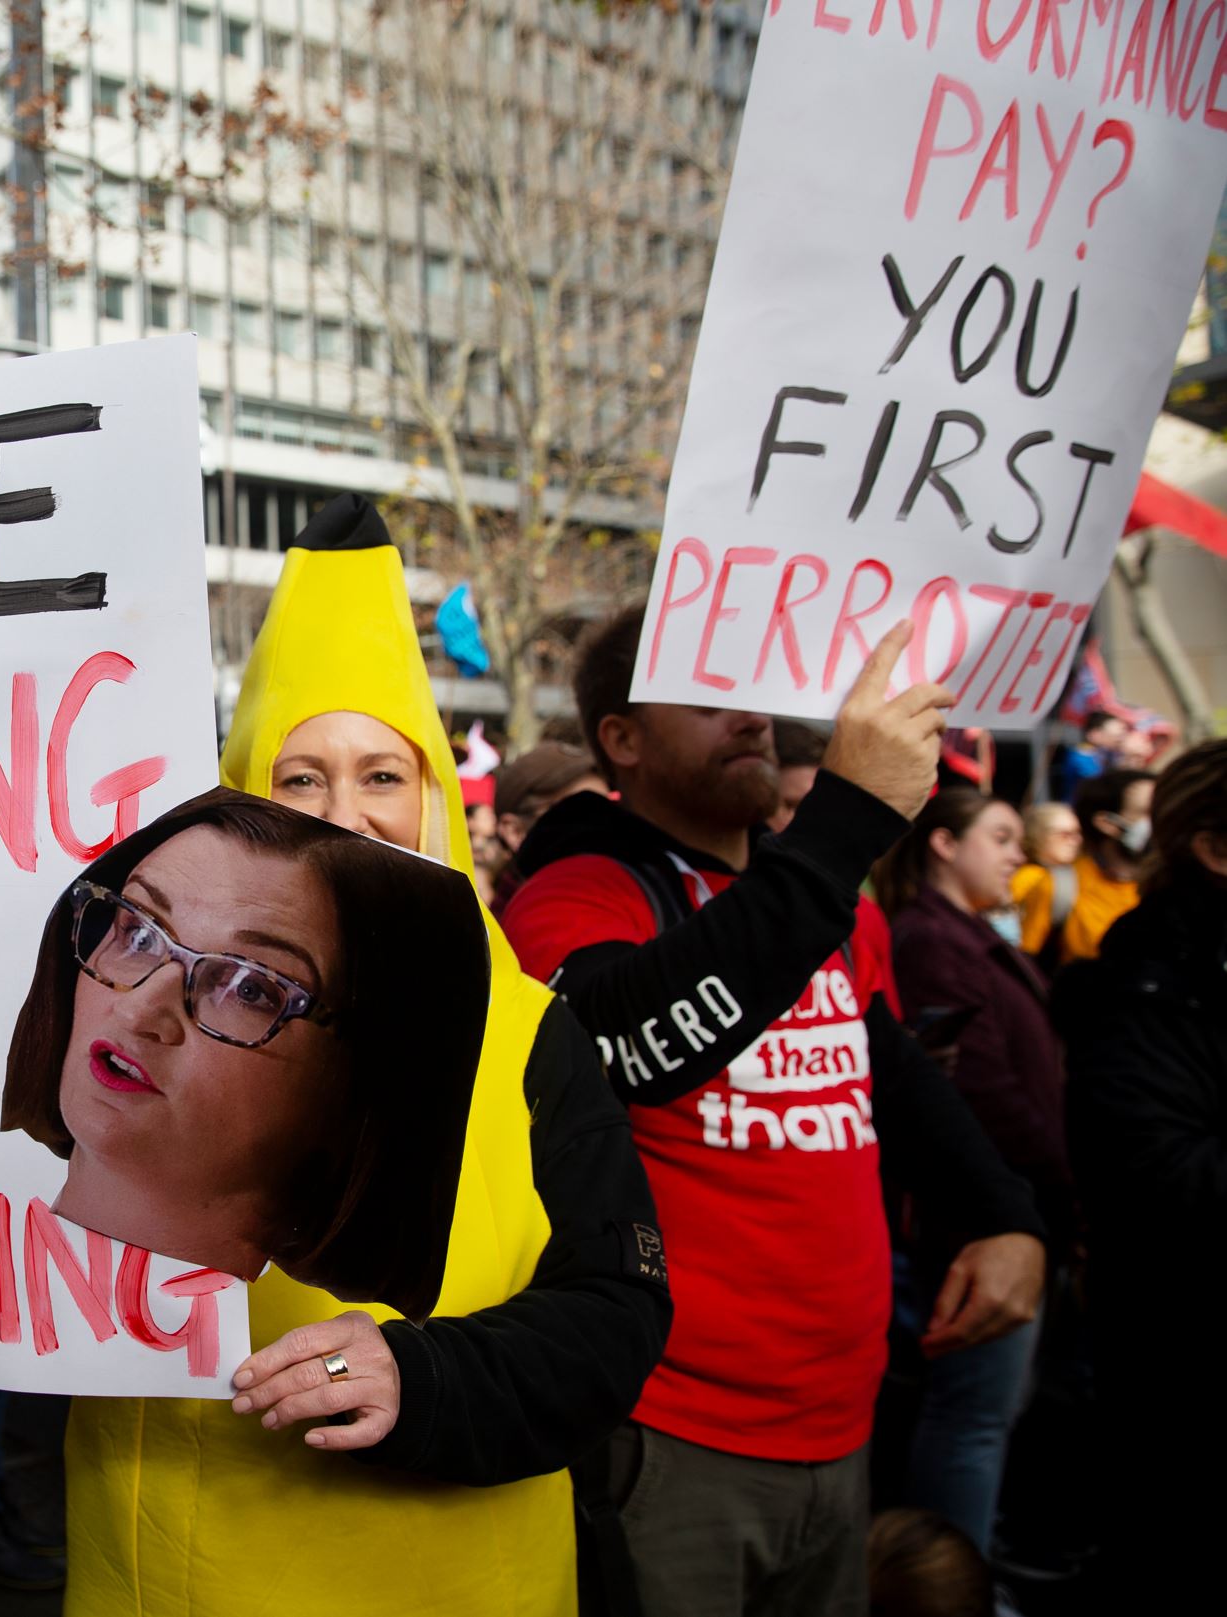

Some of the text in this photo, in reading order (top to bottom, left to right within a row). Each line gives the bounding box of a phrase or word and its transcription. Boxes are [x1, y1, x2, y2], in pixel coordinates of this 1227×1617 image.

[903, 73, 1135, 260] PAY?
[878, 253, 1078, 398] YOU
[747, 385, 1114, 560] FIRST
[757, 1037, 857, 1080] than
